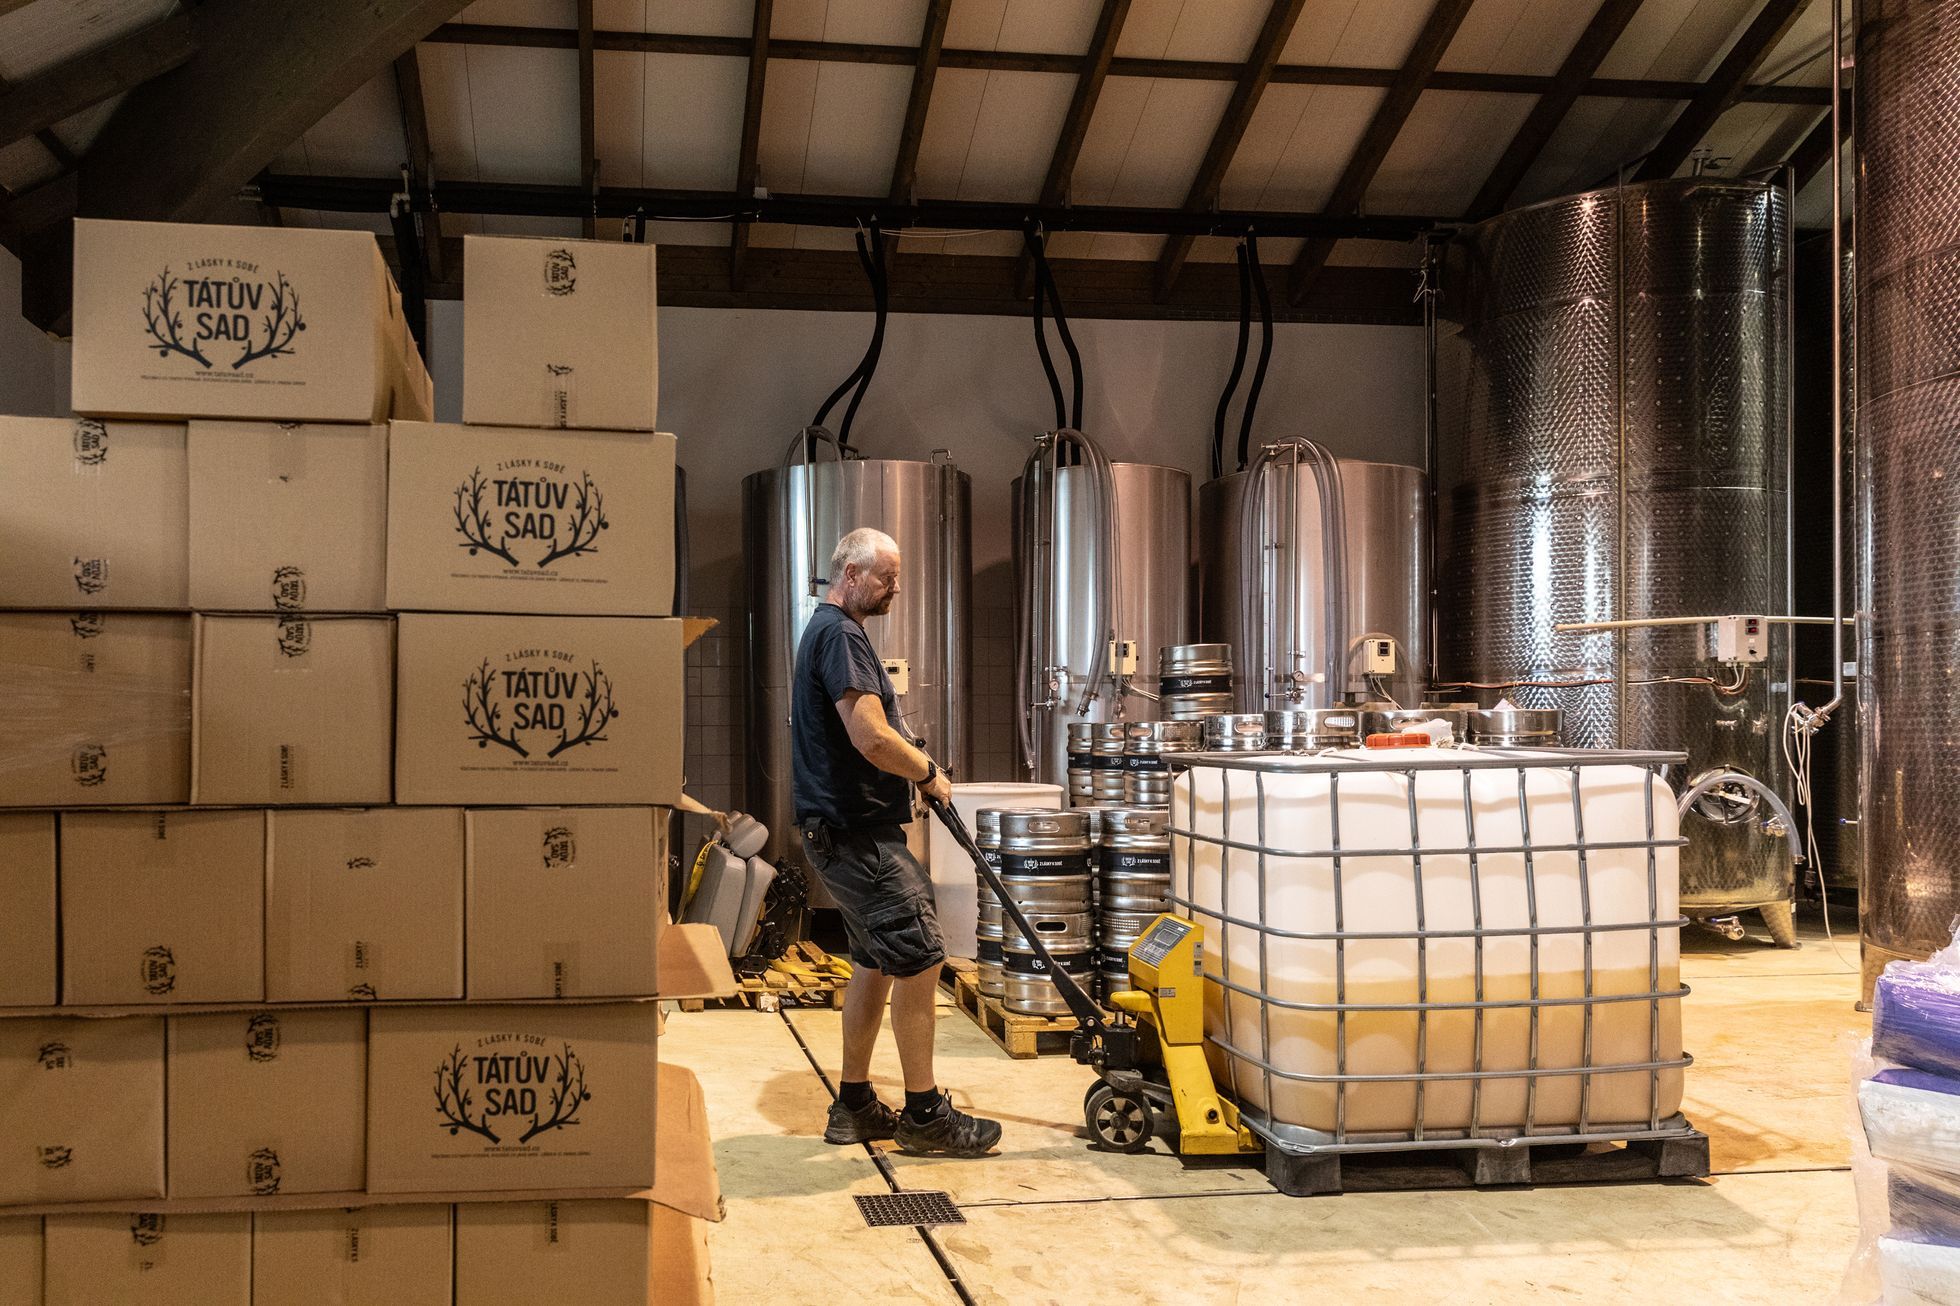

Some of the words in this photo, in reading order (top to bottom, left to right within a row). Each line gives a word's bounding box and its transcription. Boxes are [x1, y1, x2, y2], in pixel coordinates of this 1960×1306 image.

[183, 276, 262, 310] TÁTŮV
[196, 313, 250, 341] SAD
[492, 476, 568, 509] TÁTŮV
[504, 512, 555, 540] SAD
[501, 666, 578, 699] TÁTŮV
[514, 703, 564, 730] SAD
[472, 1050, 550, 1084] TÁTŮV
[484, 1088, 536, 1116] SAD
